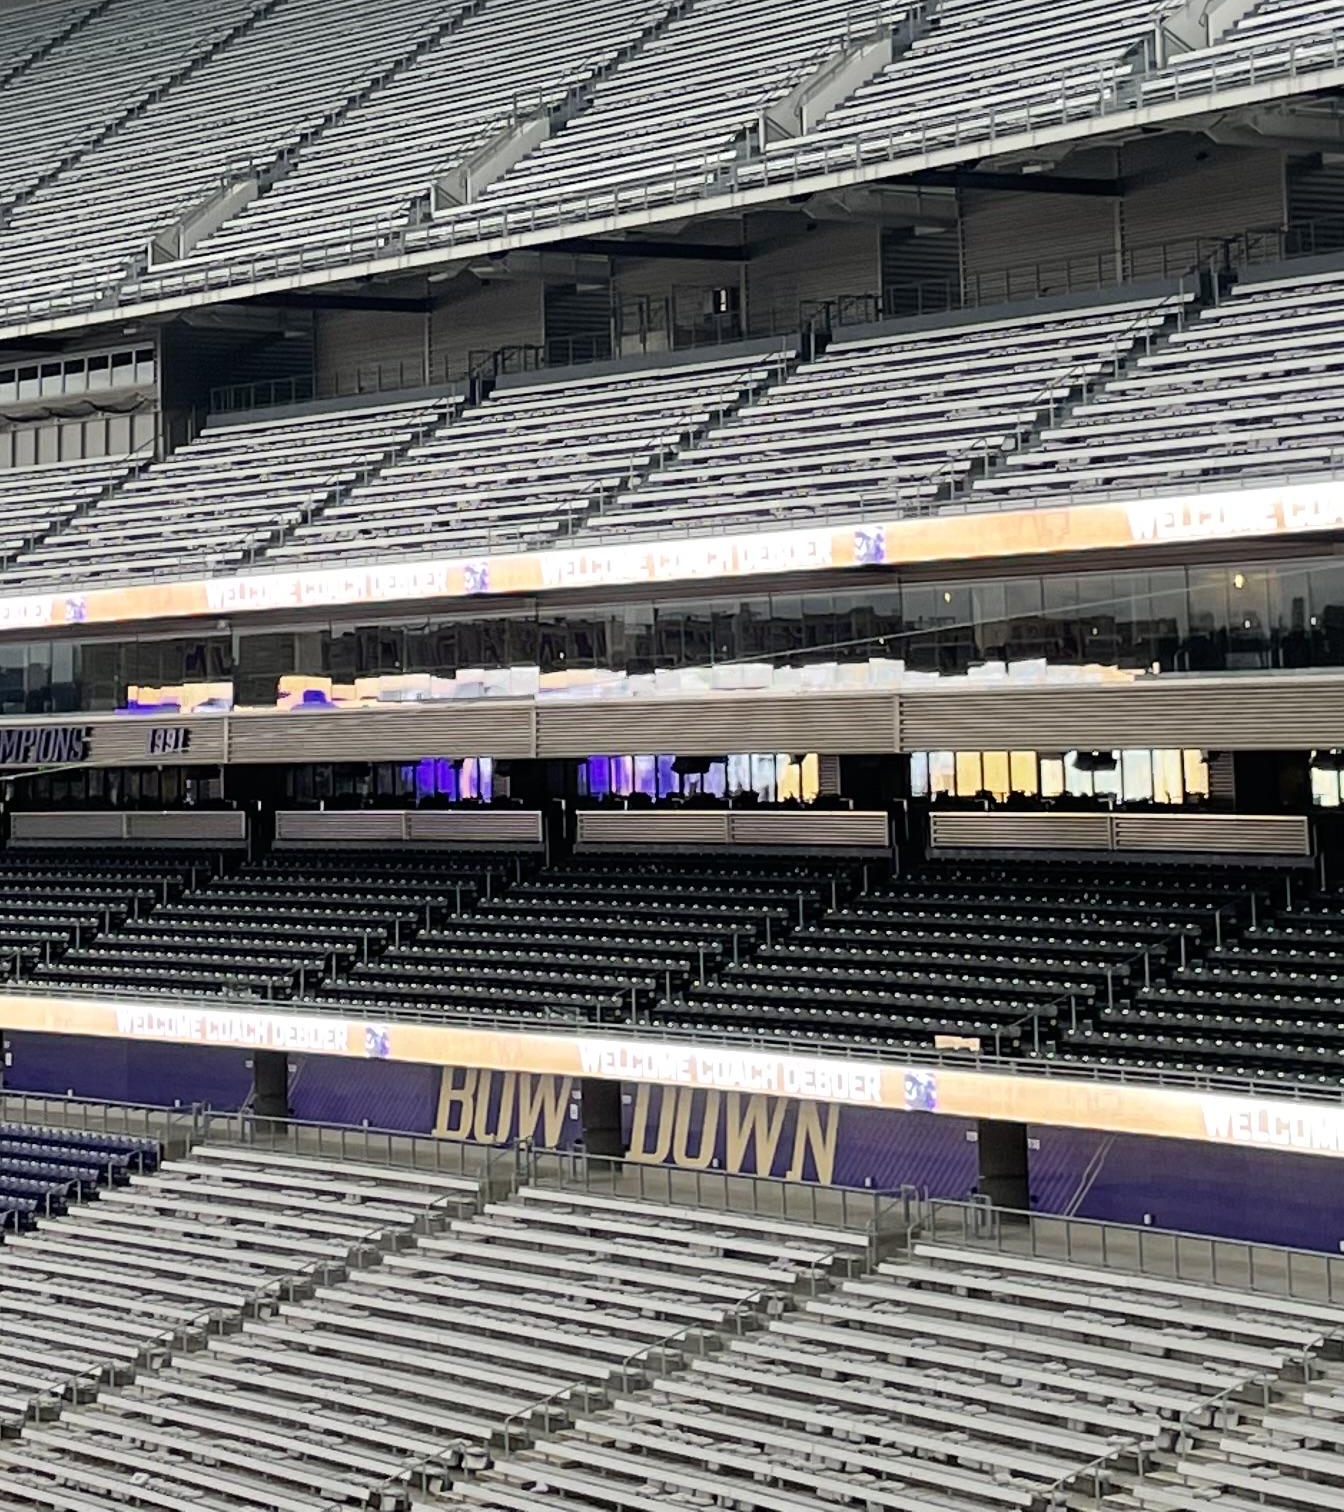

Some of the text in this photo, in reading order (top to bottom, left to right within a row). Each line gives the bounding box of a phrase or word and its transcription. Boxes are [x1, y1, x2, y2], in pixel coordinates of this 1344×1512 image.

[1129, 495, 1275, 540] WELCOME
[147, 728, 189, 754] 1991
[115, 1008, 347, 1051] WELCOME COACH DEBOER
[576, 1042, 880, 1101] WELCOME COACH DEBOER
[430, 1065, 840, 1186] BOW DOWN
